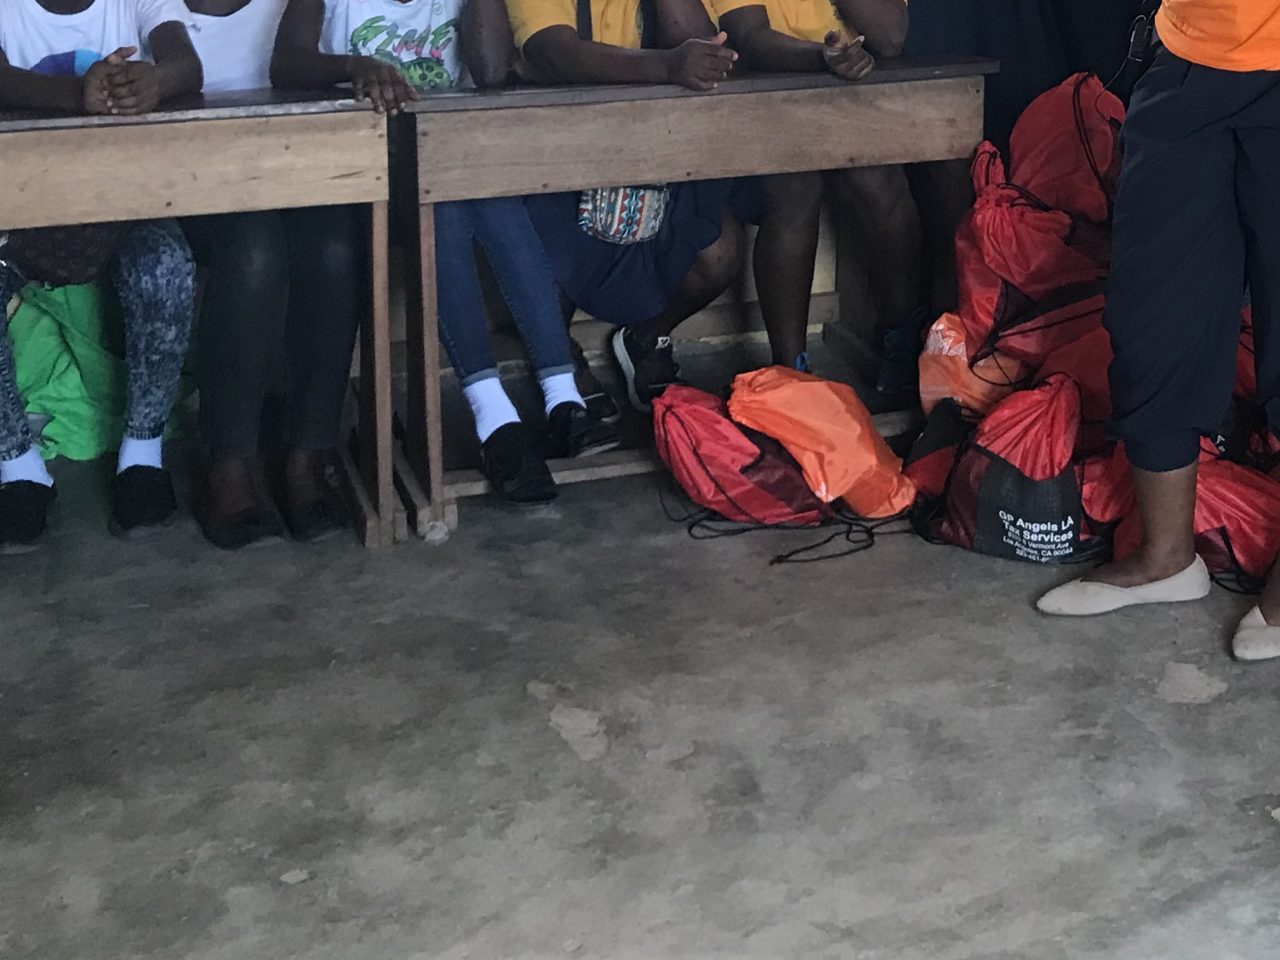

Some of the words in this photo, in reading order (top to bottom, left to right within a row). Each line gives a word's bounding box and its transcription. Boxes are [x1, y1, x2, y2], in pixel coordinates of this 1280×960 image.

[999, 510, 1014, 522] GP
[1016, 518, 1058, 532] Angels
[1062, 516, 1074, 530] LA
[1003, 520, 1020, 536] Tax
[1023, 530, 1073, 542] Services
